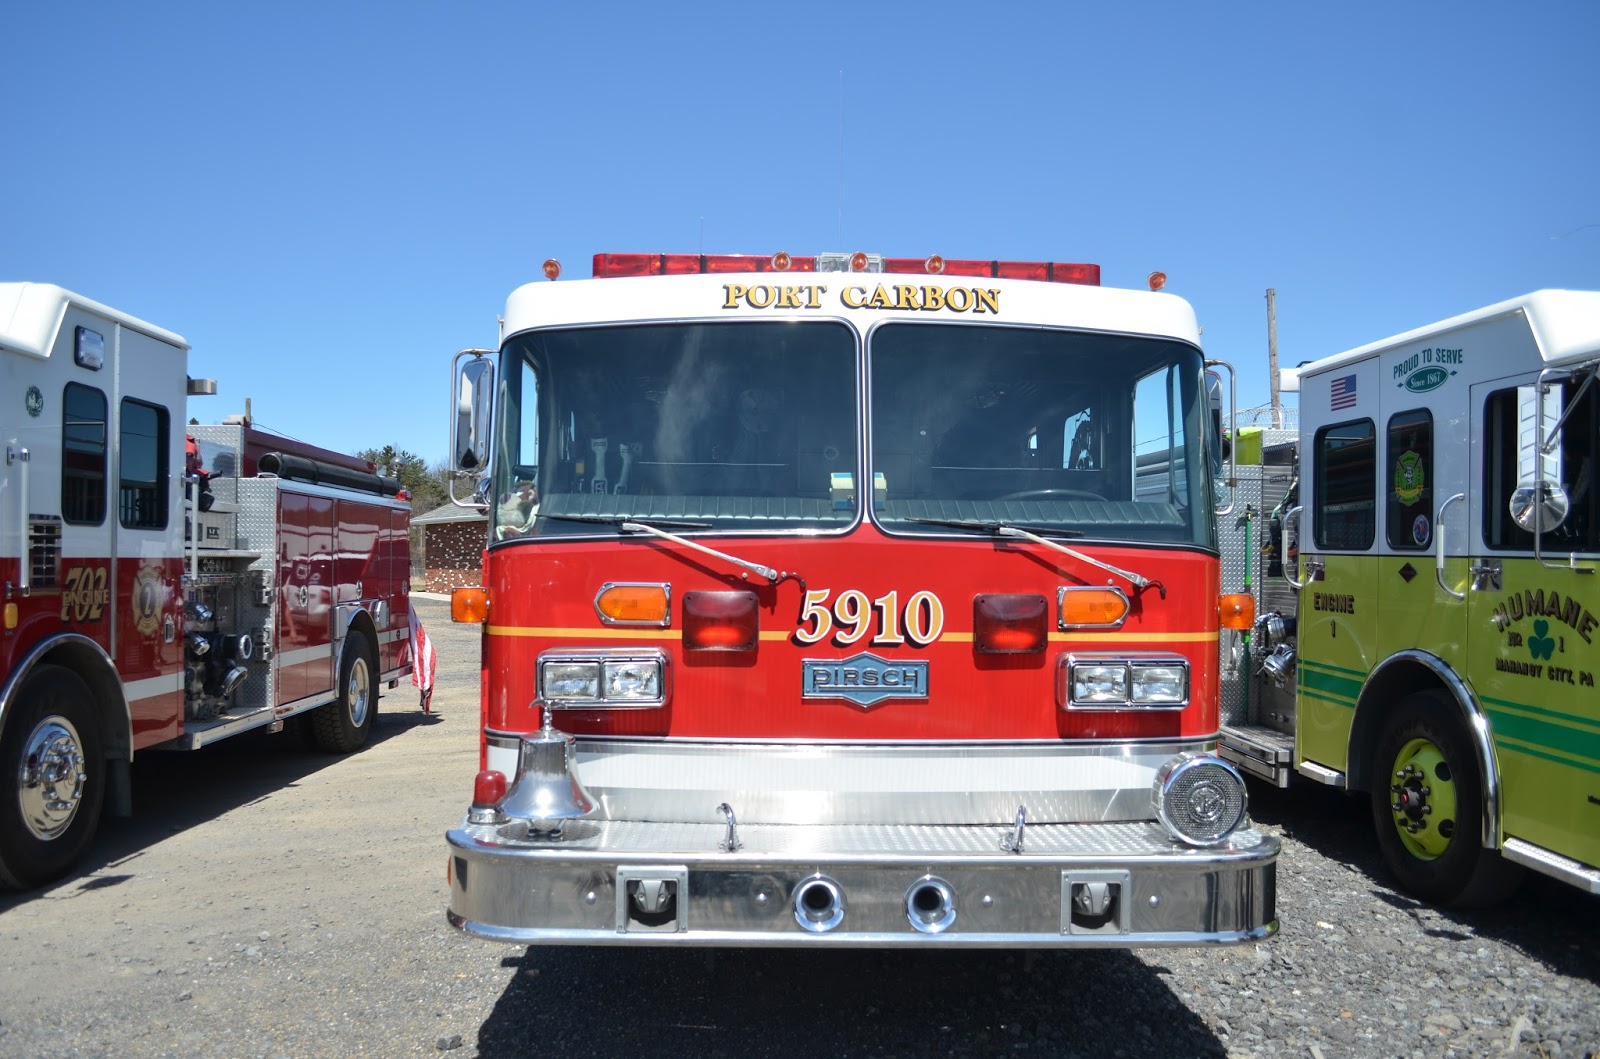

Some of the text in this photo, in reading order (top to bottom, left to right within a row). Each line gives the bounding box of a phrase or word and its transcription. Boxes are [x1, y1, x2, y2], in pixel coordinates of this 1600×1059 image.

[722, 283, 1001, 314] PORT CARBON
[1394, 348, 1463, 379] PROUD TO SERVE
[1410, 377, 1425, 389] Since
[60, 566, 108, 624] 702
[62, 590, 110, 606] ENGINE
[1314, 592, 1354, 614] ENGINE
[792, 588, 944, 649] 5910
[1330, 619, 1336, 638] 1
[1491, 588, 1600, 645] HUMANE
[1559, 636, 1564, 653] 1
[813, 666, 919, 692] PIRSCH
[1579, 670, 1595, 688] PA
